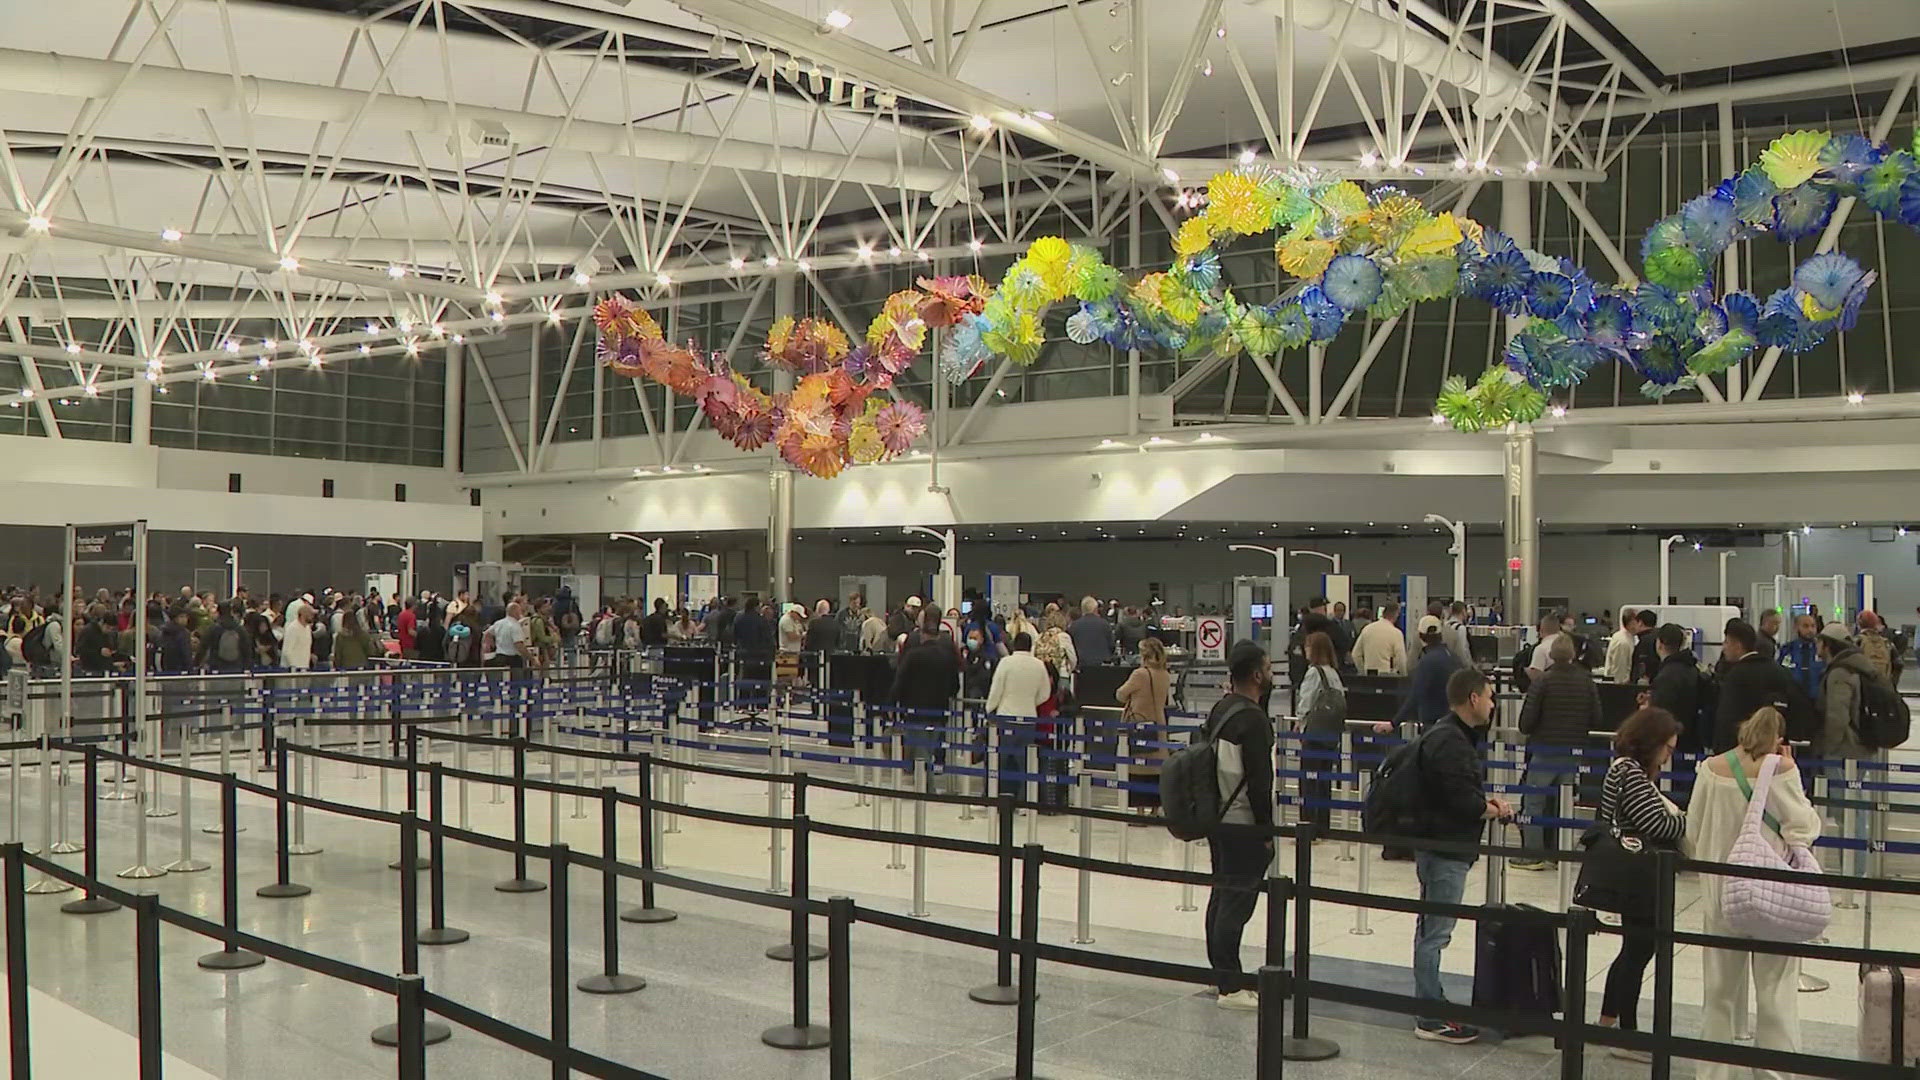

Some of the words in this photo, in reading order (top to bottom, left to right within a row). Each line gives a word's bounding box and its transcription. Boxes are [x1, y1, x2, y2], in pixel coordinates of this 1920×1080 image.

[1848, 781, 1862, 789] IAH
[1517, 816, 1531, 824] IAH
[1872, 841, 1885, 851] AH
